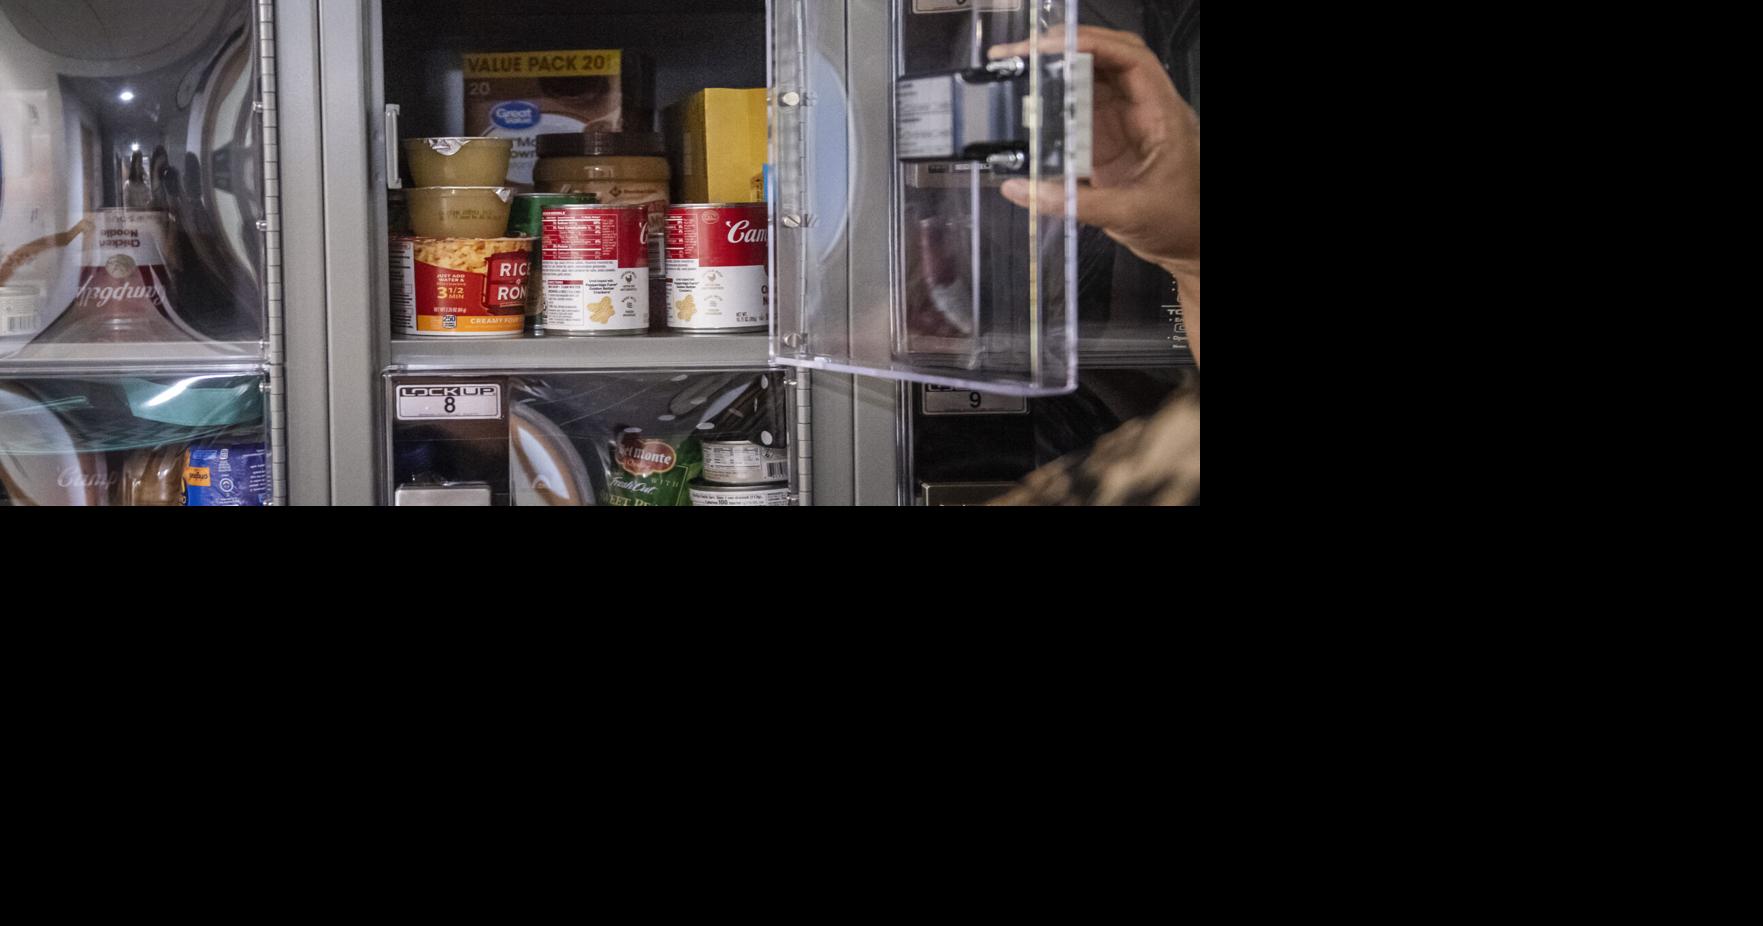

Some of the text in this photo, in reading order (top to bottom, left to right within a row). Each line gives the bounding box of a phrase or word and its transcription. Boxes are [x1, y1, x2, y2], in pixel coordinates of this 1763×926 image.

[467, 57, 522, 72] VALUE
[528, 56, 577, 72] PACK
[470, 83, 490, 95] 20
[496, 108, 532, 118] Great
[101, 229, 138, 238] Noodle
[99, 240, 140, 248] Chicken
[437, 286, 448, 299] 3
[444, 397, 456, 413] 8
[969, 391, 981, 408] 9
